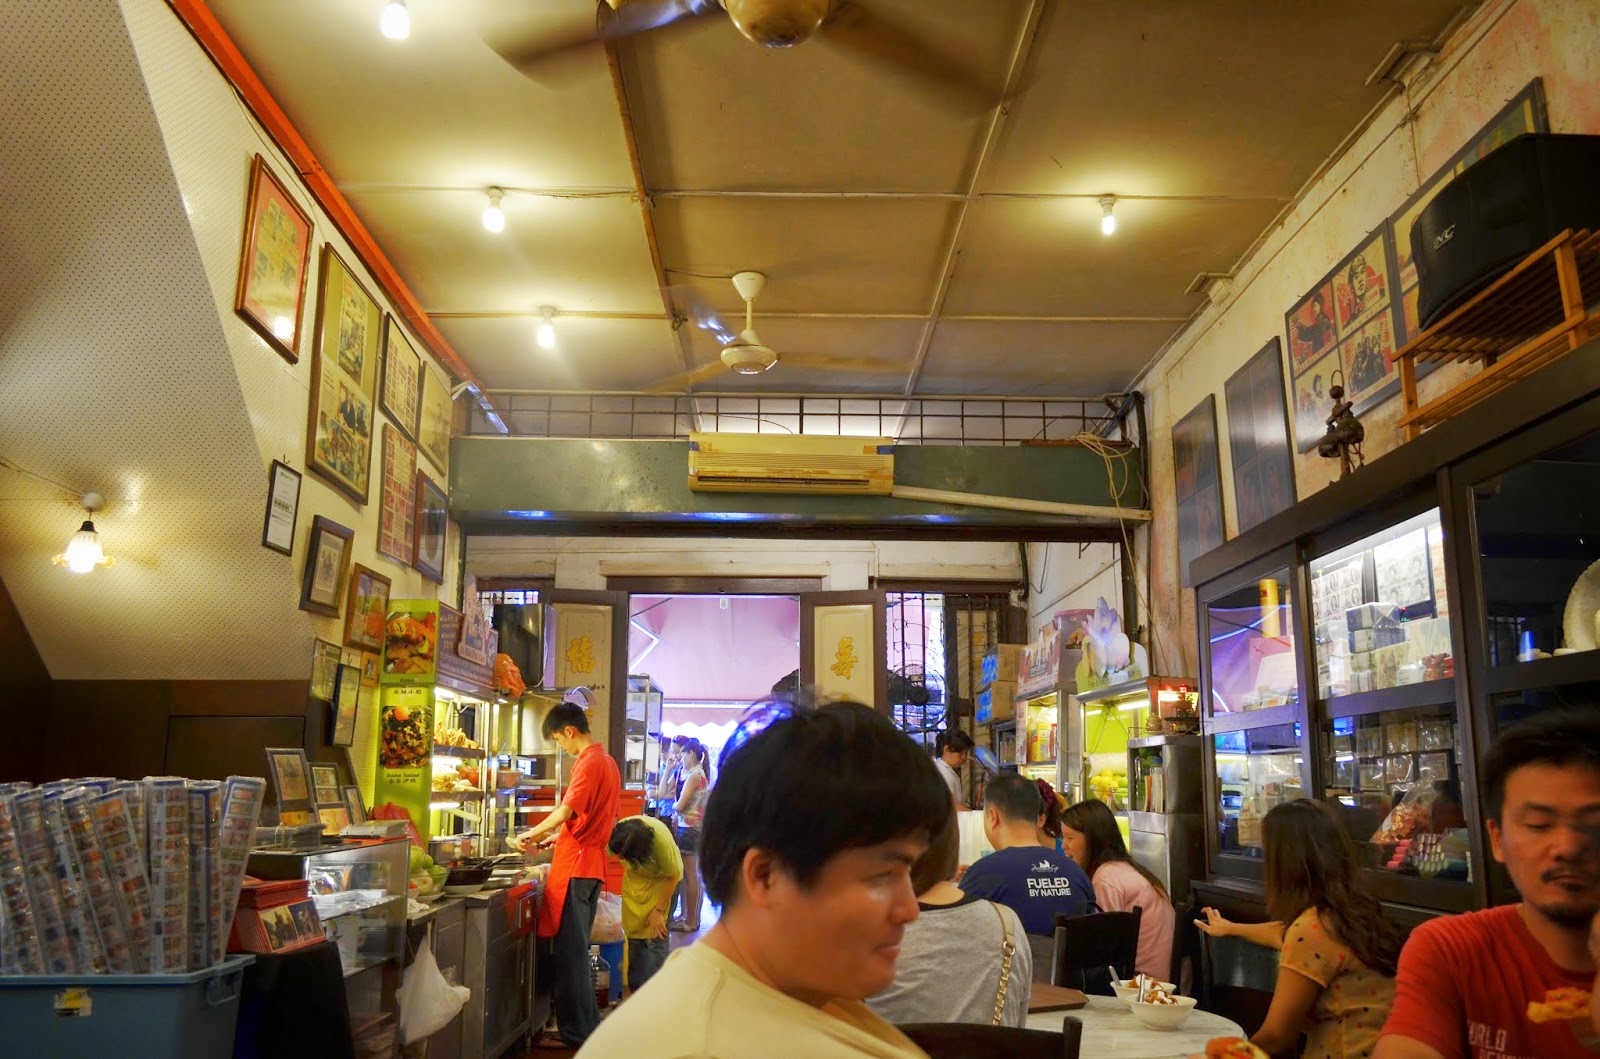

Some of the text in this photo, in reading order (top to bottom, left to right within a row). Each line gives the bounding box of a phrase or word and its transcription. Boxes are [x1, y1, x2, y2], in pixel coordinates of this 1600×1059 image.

[566, 635, 596, 674] 福
[1027, 877, 1069, 889] FUELED
[1029, 888, 1072, 897] BY NATURE
[1467, 1021, 1507, 1052] ORLD
